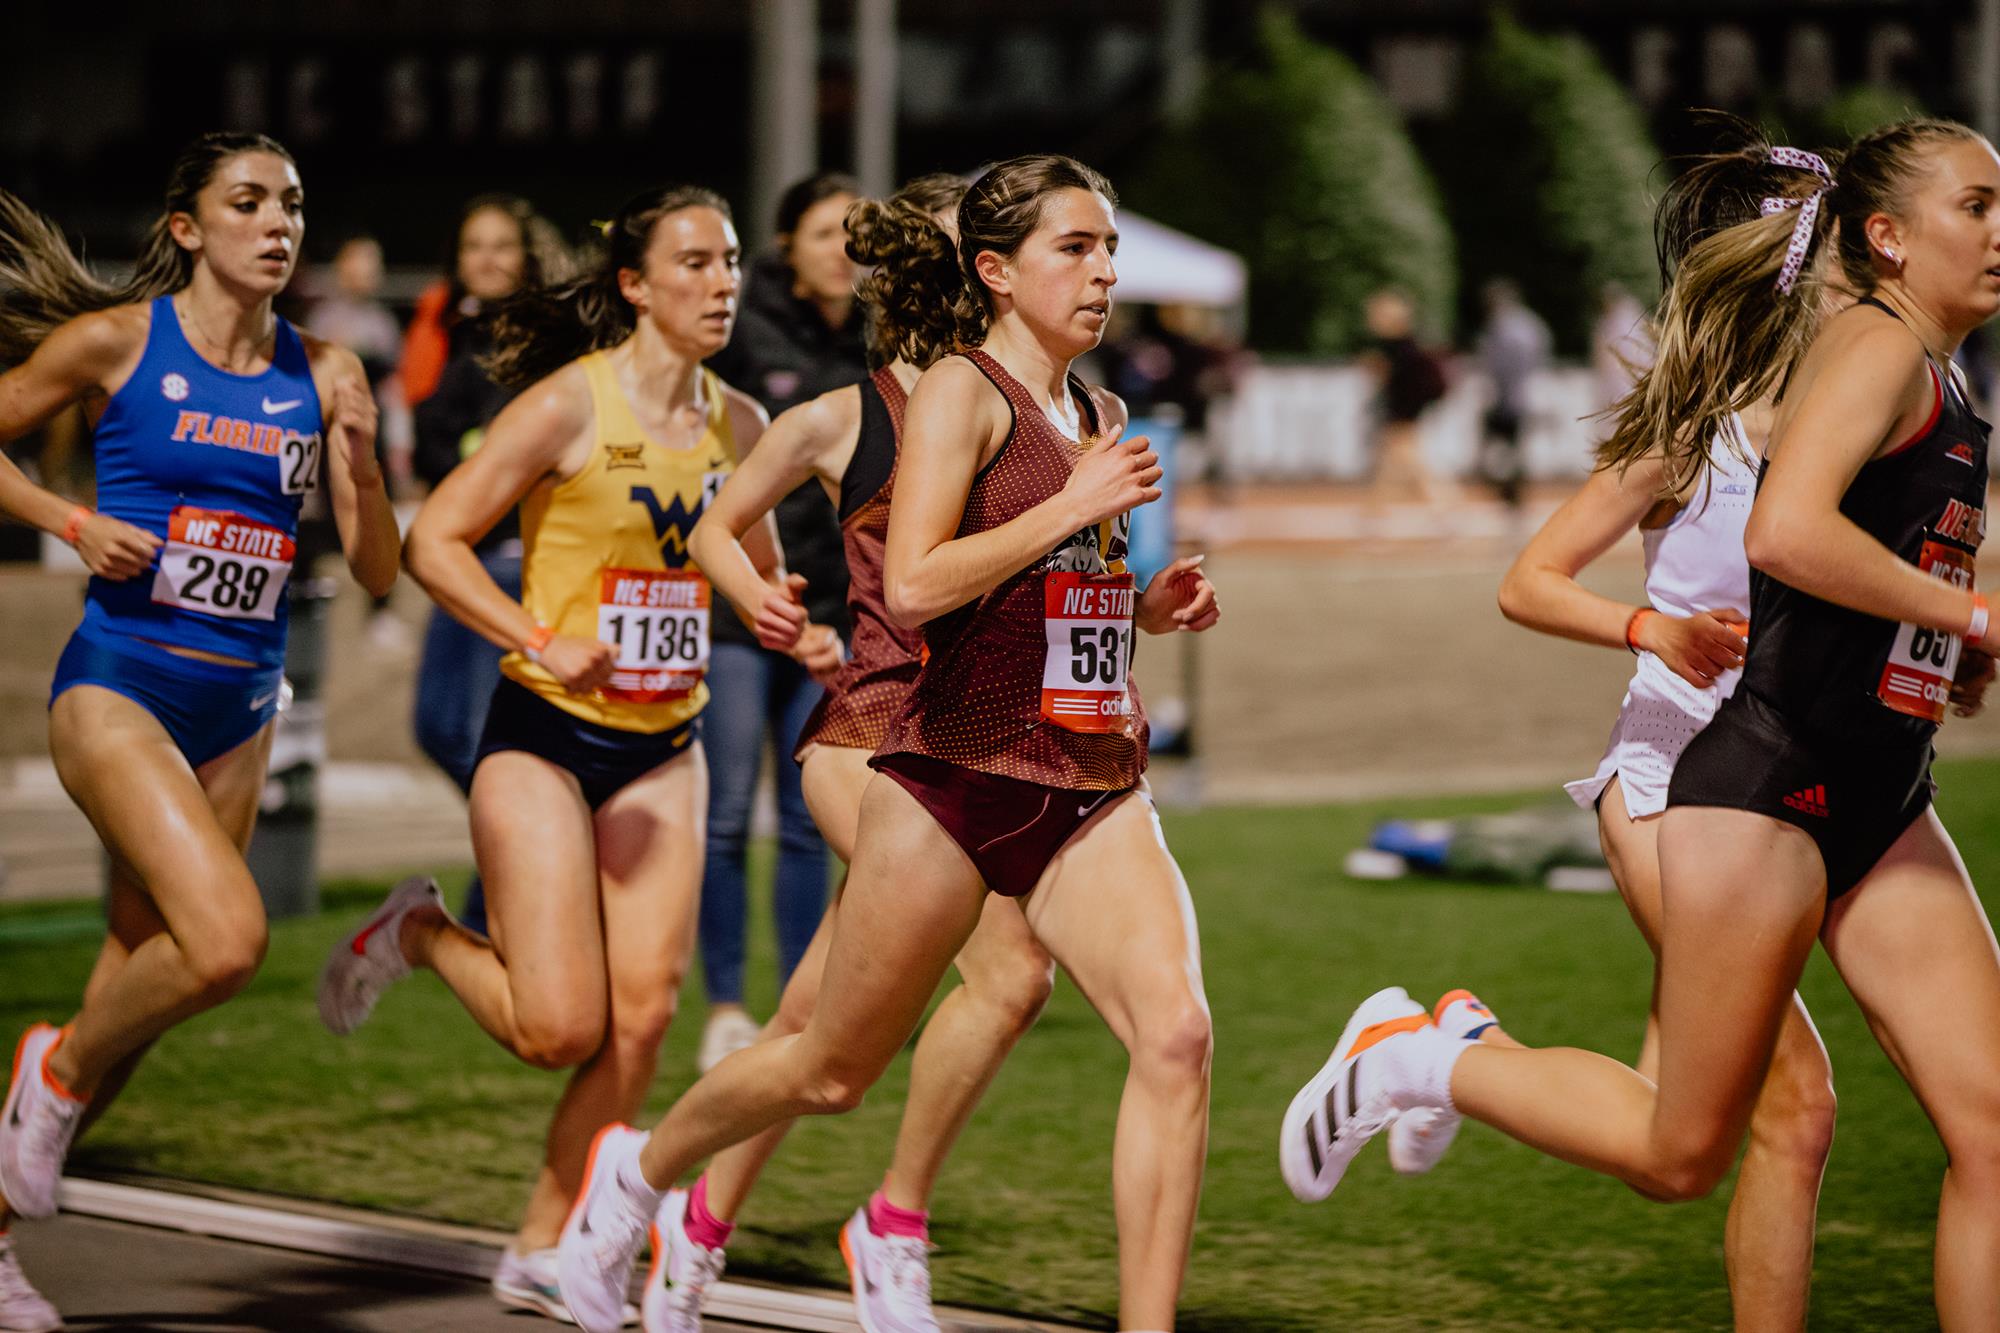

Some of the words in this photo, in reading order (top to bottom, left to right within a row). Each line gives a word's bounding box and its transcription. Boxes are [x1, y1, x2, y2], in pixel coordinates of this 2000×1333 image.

[171, 409, 299, 459] FLORID
[285, 440, 318, 489] 22
[184, 519, 221, 548] NC
[221, 524, 284, 559] STATE
[179, 554, 270, 612] 289
[613, 578, 646, 605] NC
[647, 579, 698, 608] STATE
[1063, 587, 1094, 615] NC
[1098, 588, 1134, 615] STAT
[608, 614, 699, 662] 1136
[1070, 626, 1130, 684] 531
